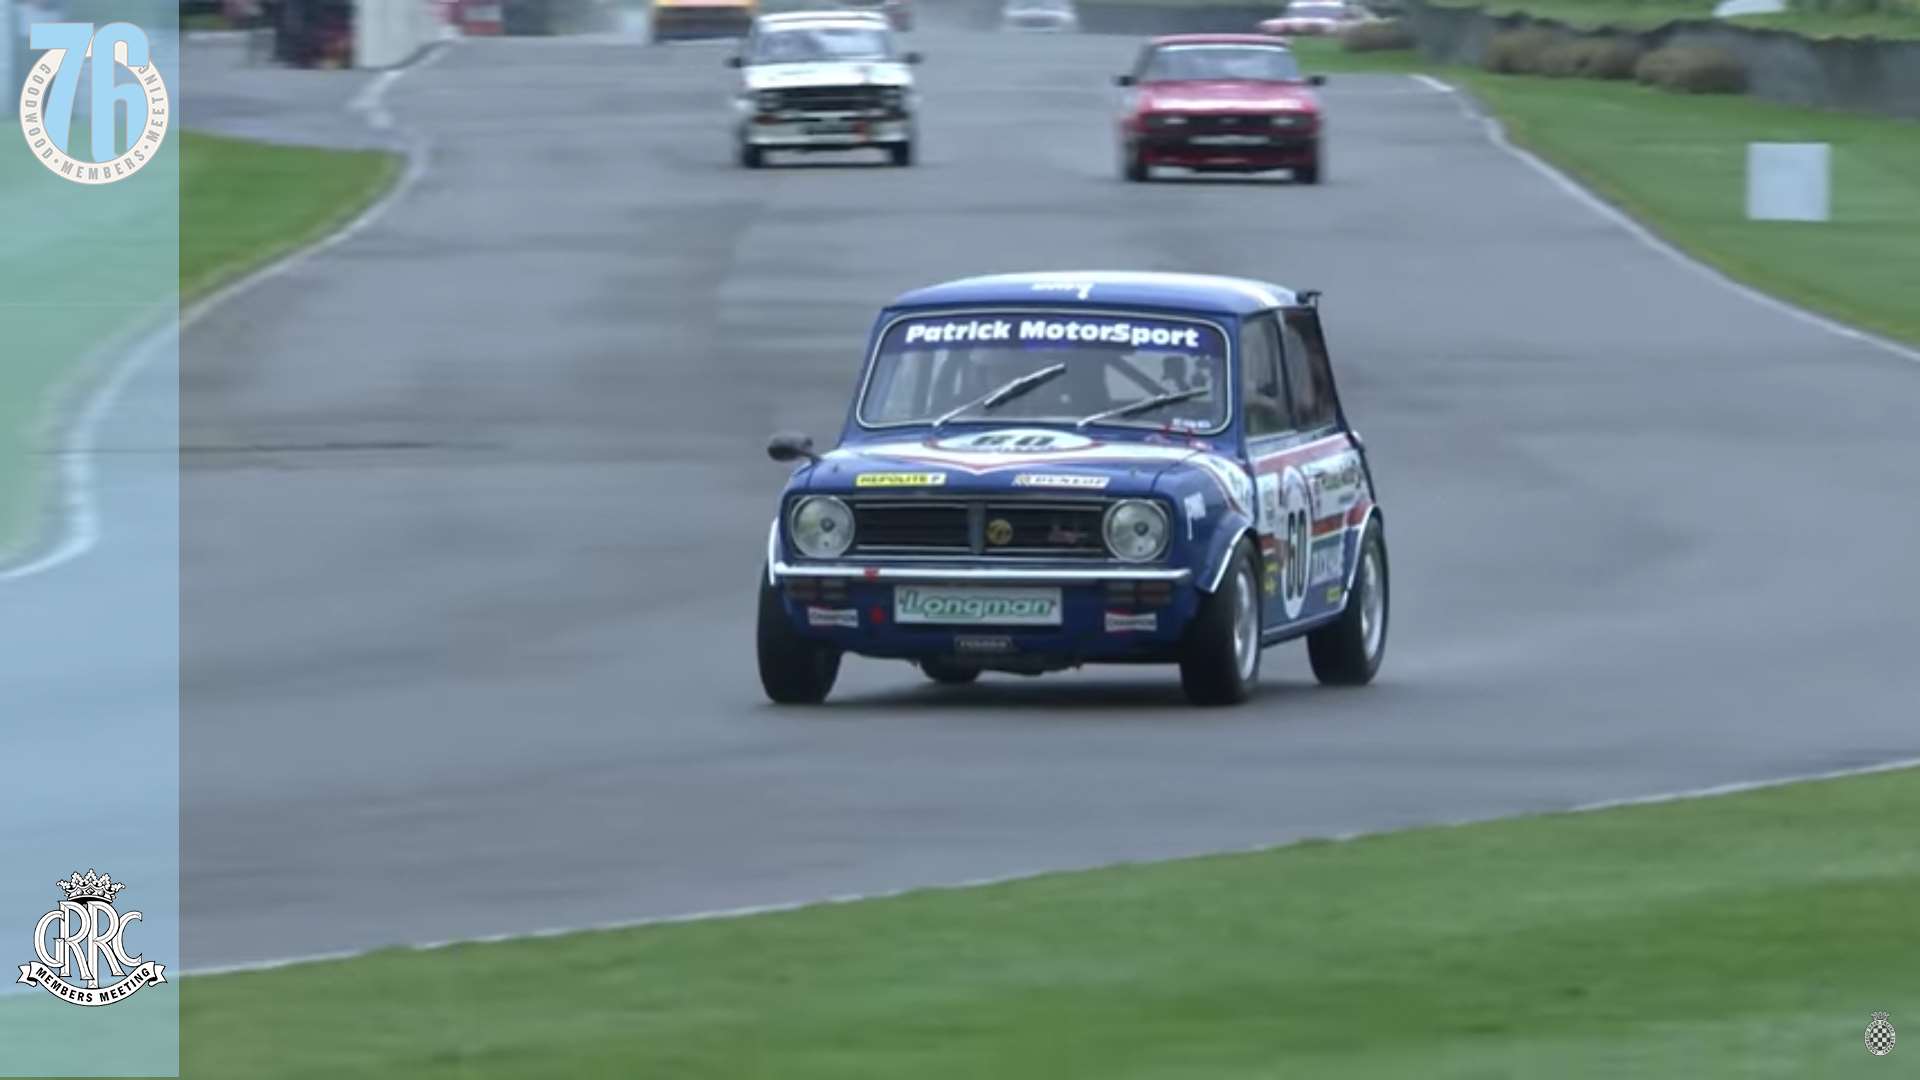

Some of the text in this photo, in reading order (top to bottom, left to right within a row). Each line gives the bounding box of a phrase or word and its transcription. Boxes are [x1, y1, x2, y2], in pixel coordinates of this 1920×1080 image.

[905, 320, 1200, 348] Patrick MotorSport
[1287, 508, 1308, 601] 60
[900, 588, 1057, 618] Longman
